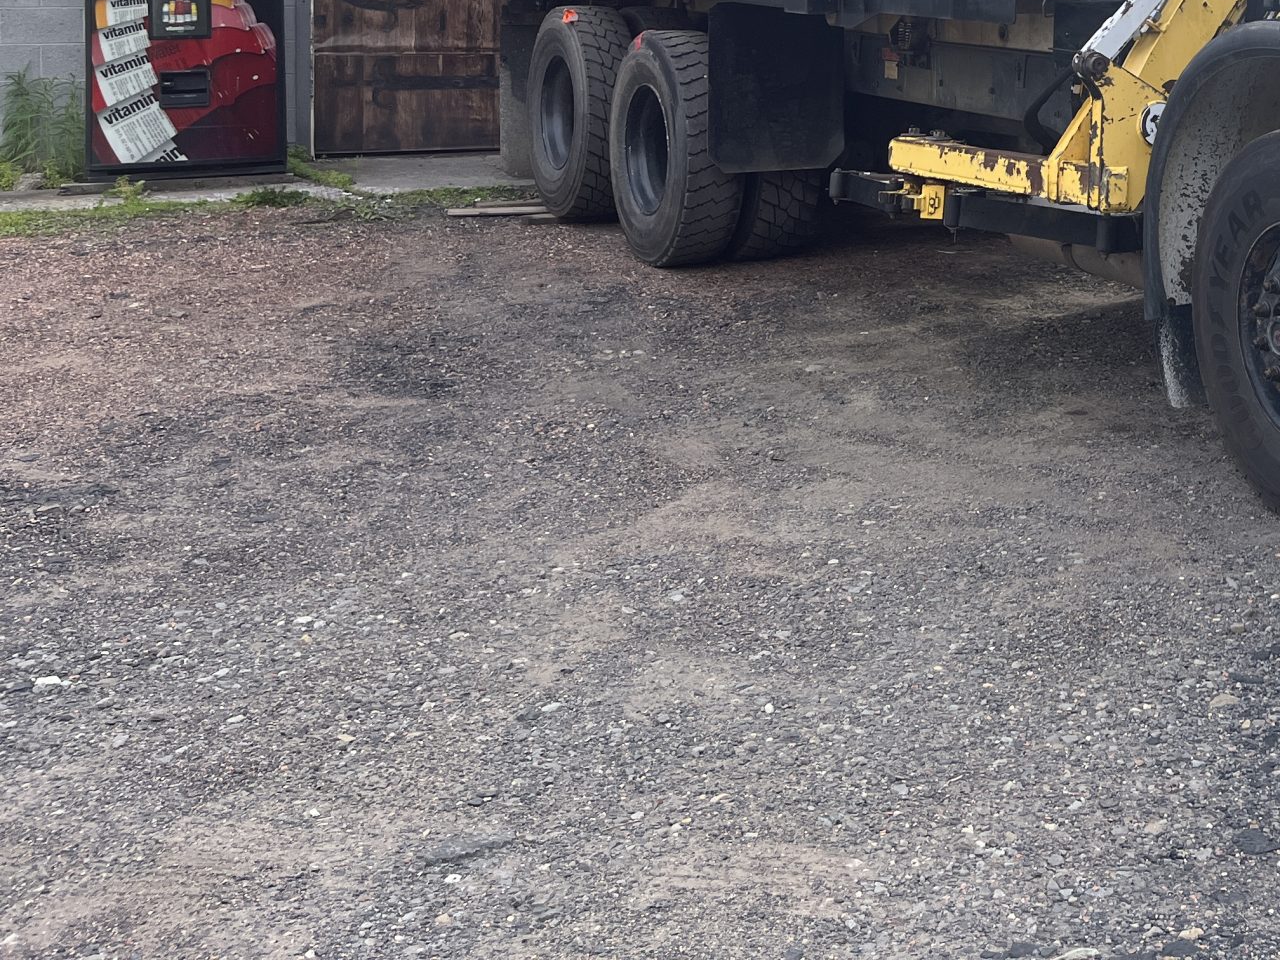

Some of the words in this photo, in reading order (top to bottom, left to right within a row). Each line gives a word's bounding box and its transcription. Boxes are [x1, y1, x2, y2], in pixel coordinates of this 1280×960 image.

[102, 22, 146, 40] vitamin
[99, 54, 152, 78] vitamin
[103, 93, 160, 125] vitamin
